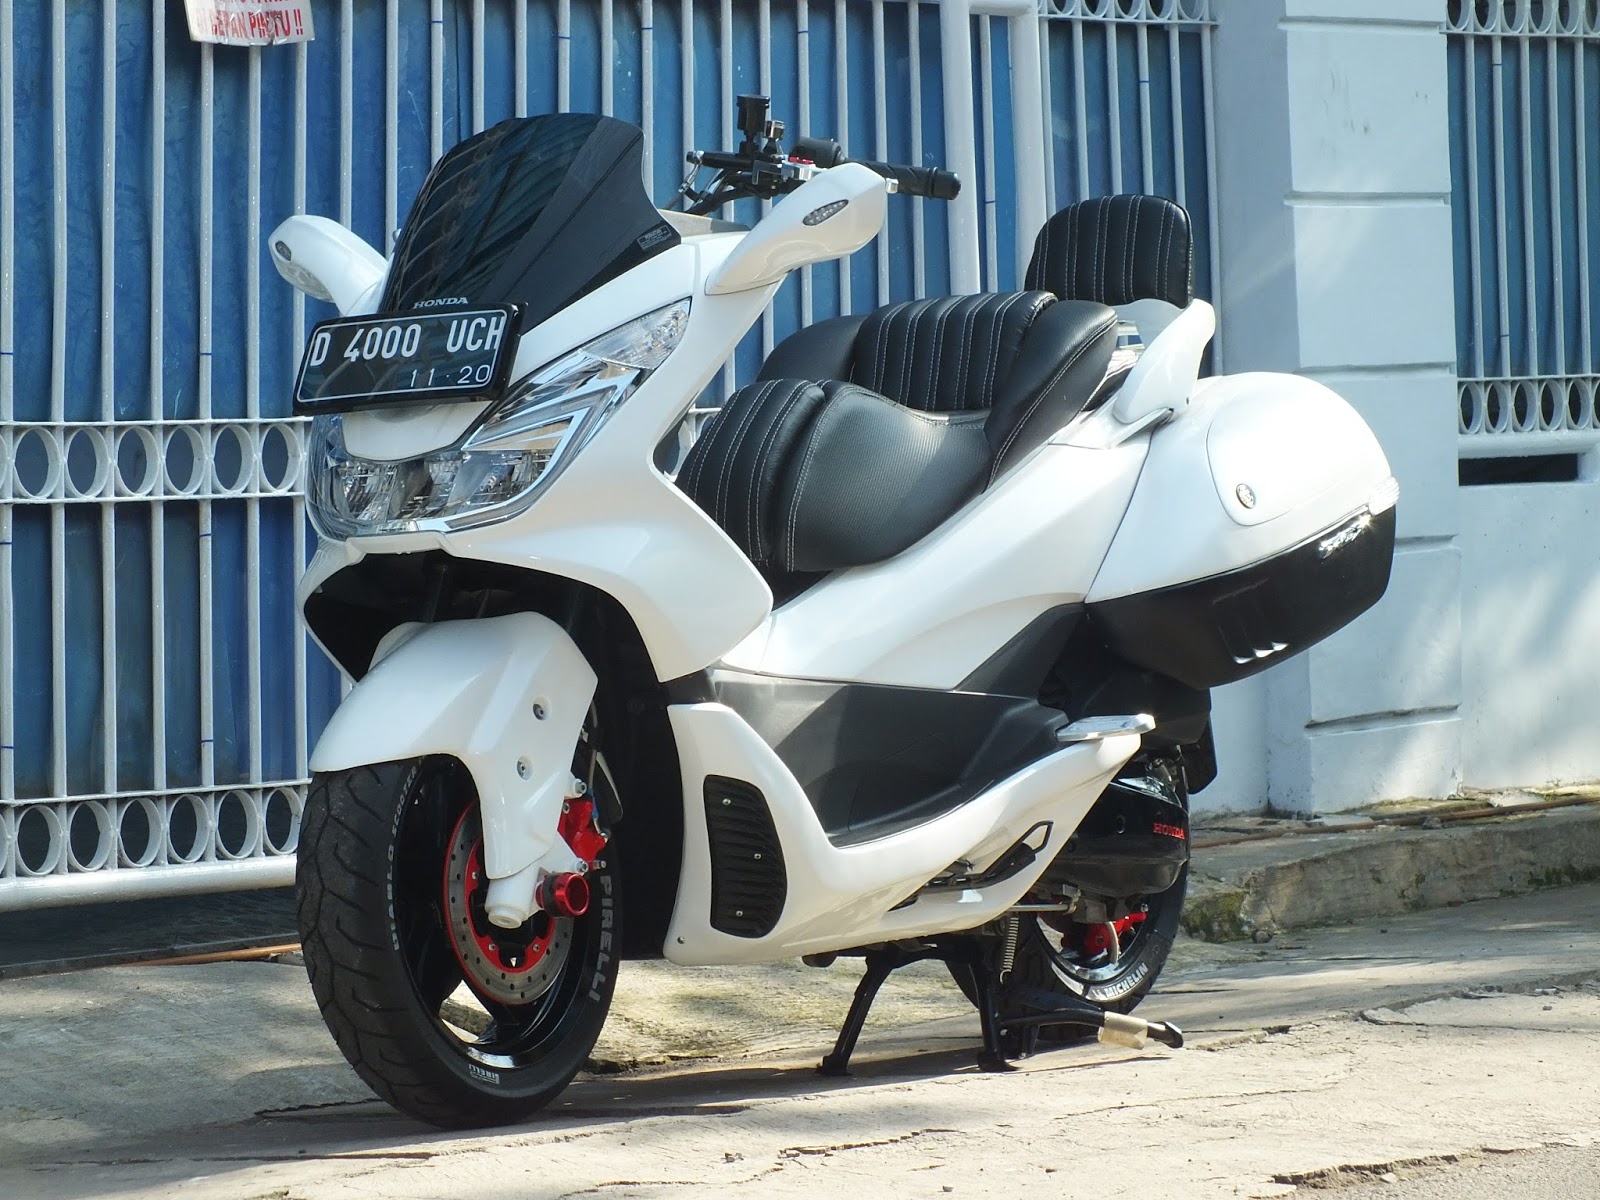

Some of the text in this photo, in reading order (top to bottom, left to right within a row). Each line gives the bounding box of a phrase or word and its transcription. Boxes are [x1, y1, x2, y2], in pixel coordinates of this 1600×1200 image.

[412, 297, 469, 309] HONDA
[310, 316, 506, 367] D 4000 UCH
[1153, 822, 1186, 840] HONDA
[588, 875, 613, 1003] PIRELLI
[1103, 962, 1149, 998] MICHELIN
[468, 1063, 500, 1085] PIRELLI
